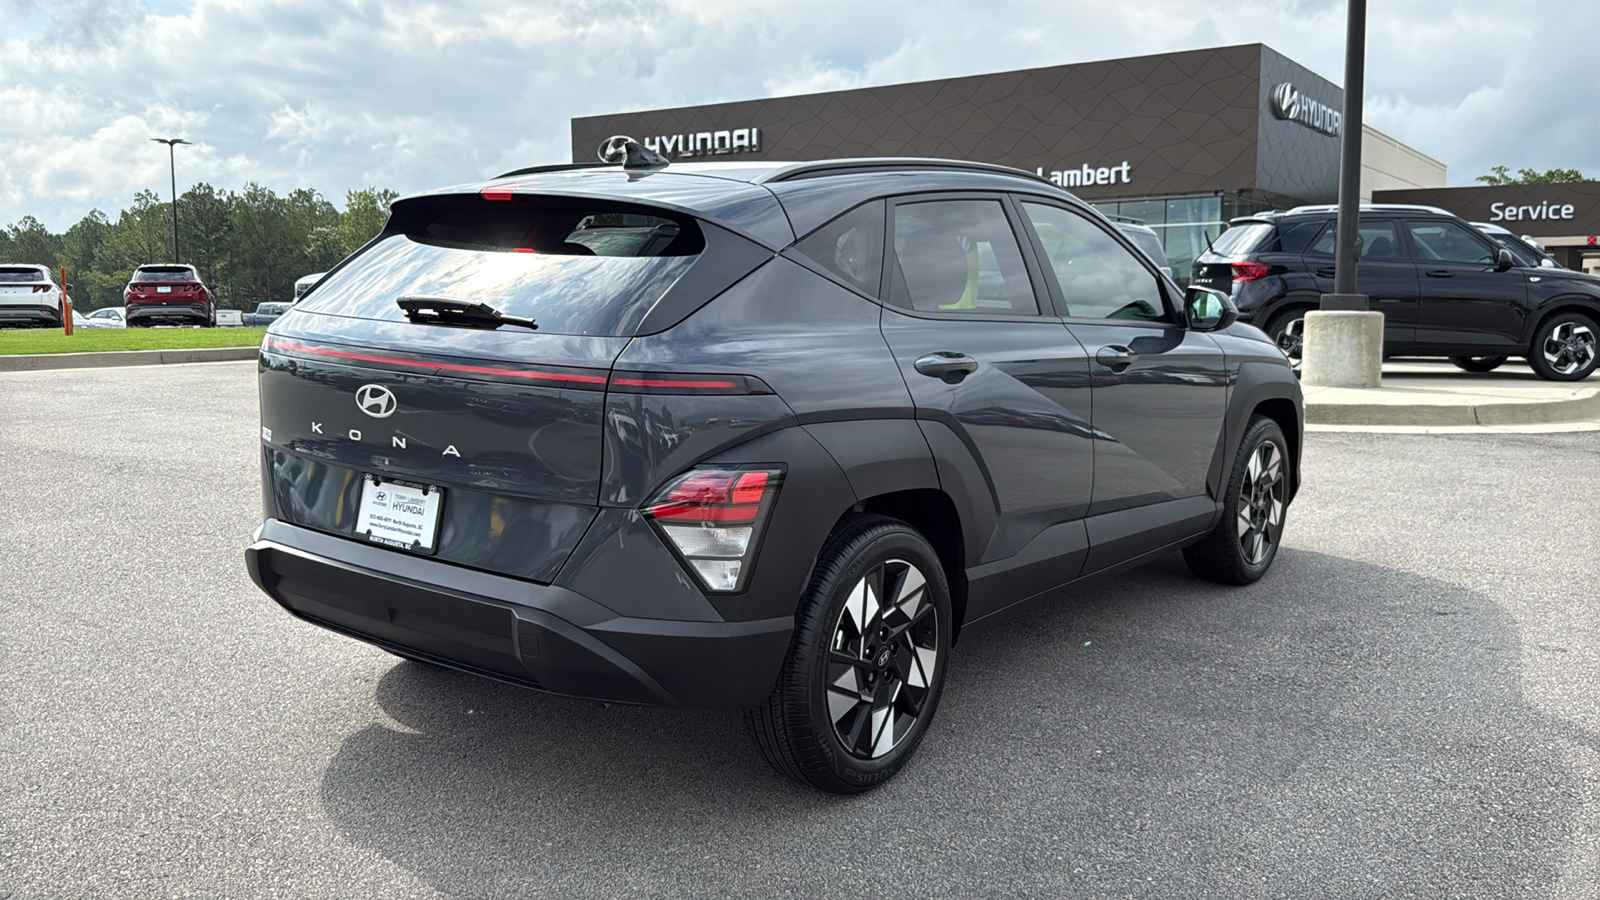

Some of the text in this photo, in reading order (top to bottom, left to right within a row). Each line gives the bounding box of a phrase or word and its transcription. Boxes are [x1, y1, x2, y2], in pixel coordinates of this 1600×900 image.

[1301, 95, 1342, 134] HYUNDAI
[644, 127, 758, 157] HYUNDAI
[1489, 200, 1574, 221] Service
[311, 421, 461, 458] KONA
[392, 502, 425, 516] HYUNDAI
[408, 496, 426, 505] LAMBERT
